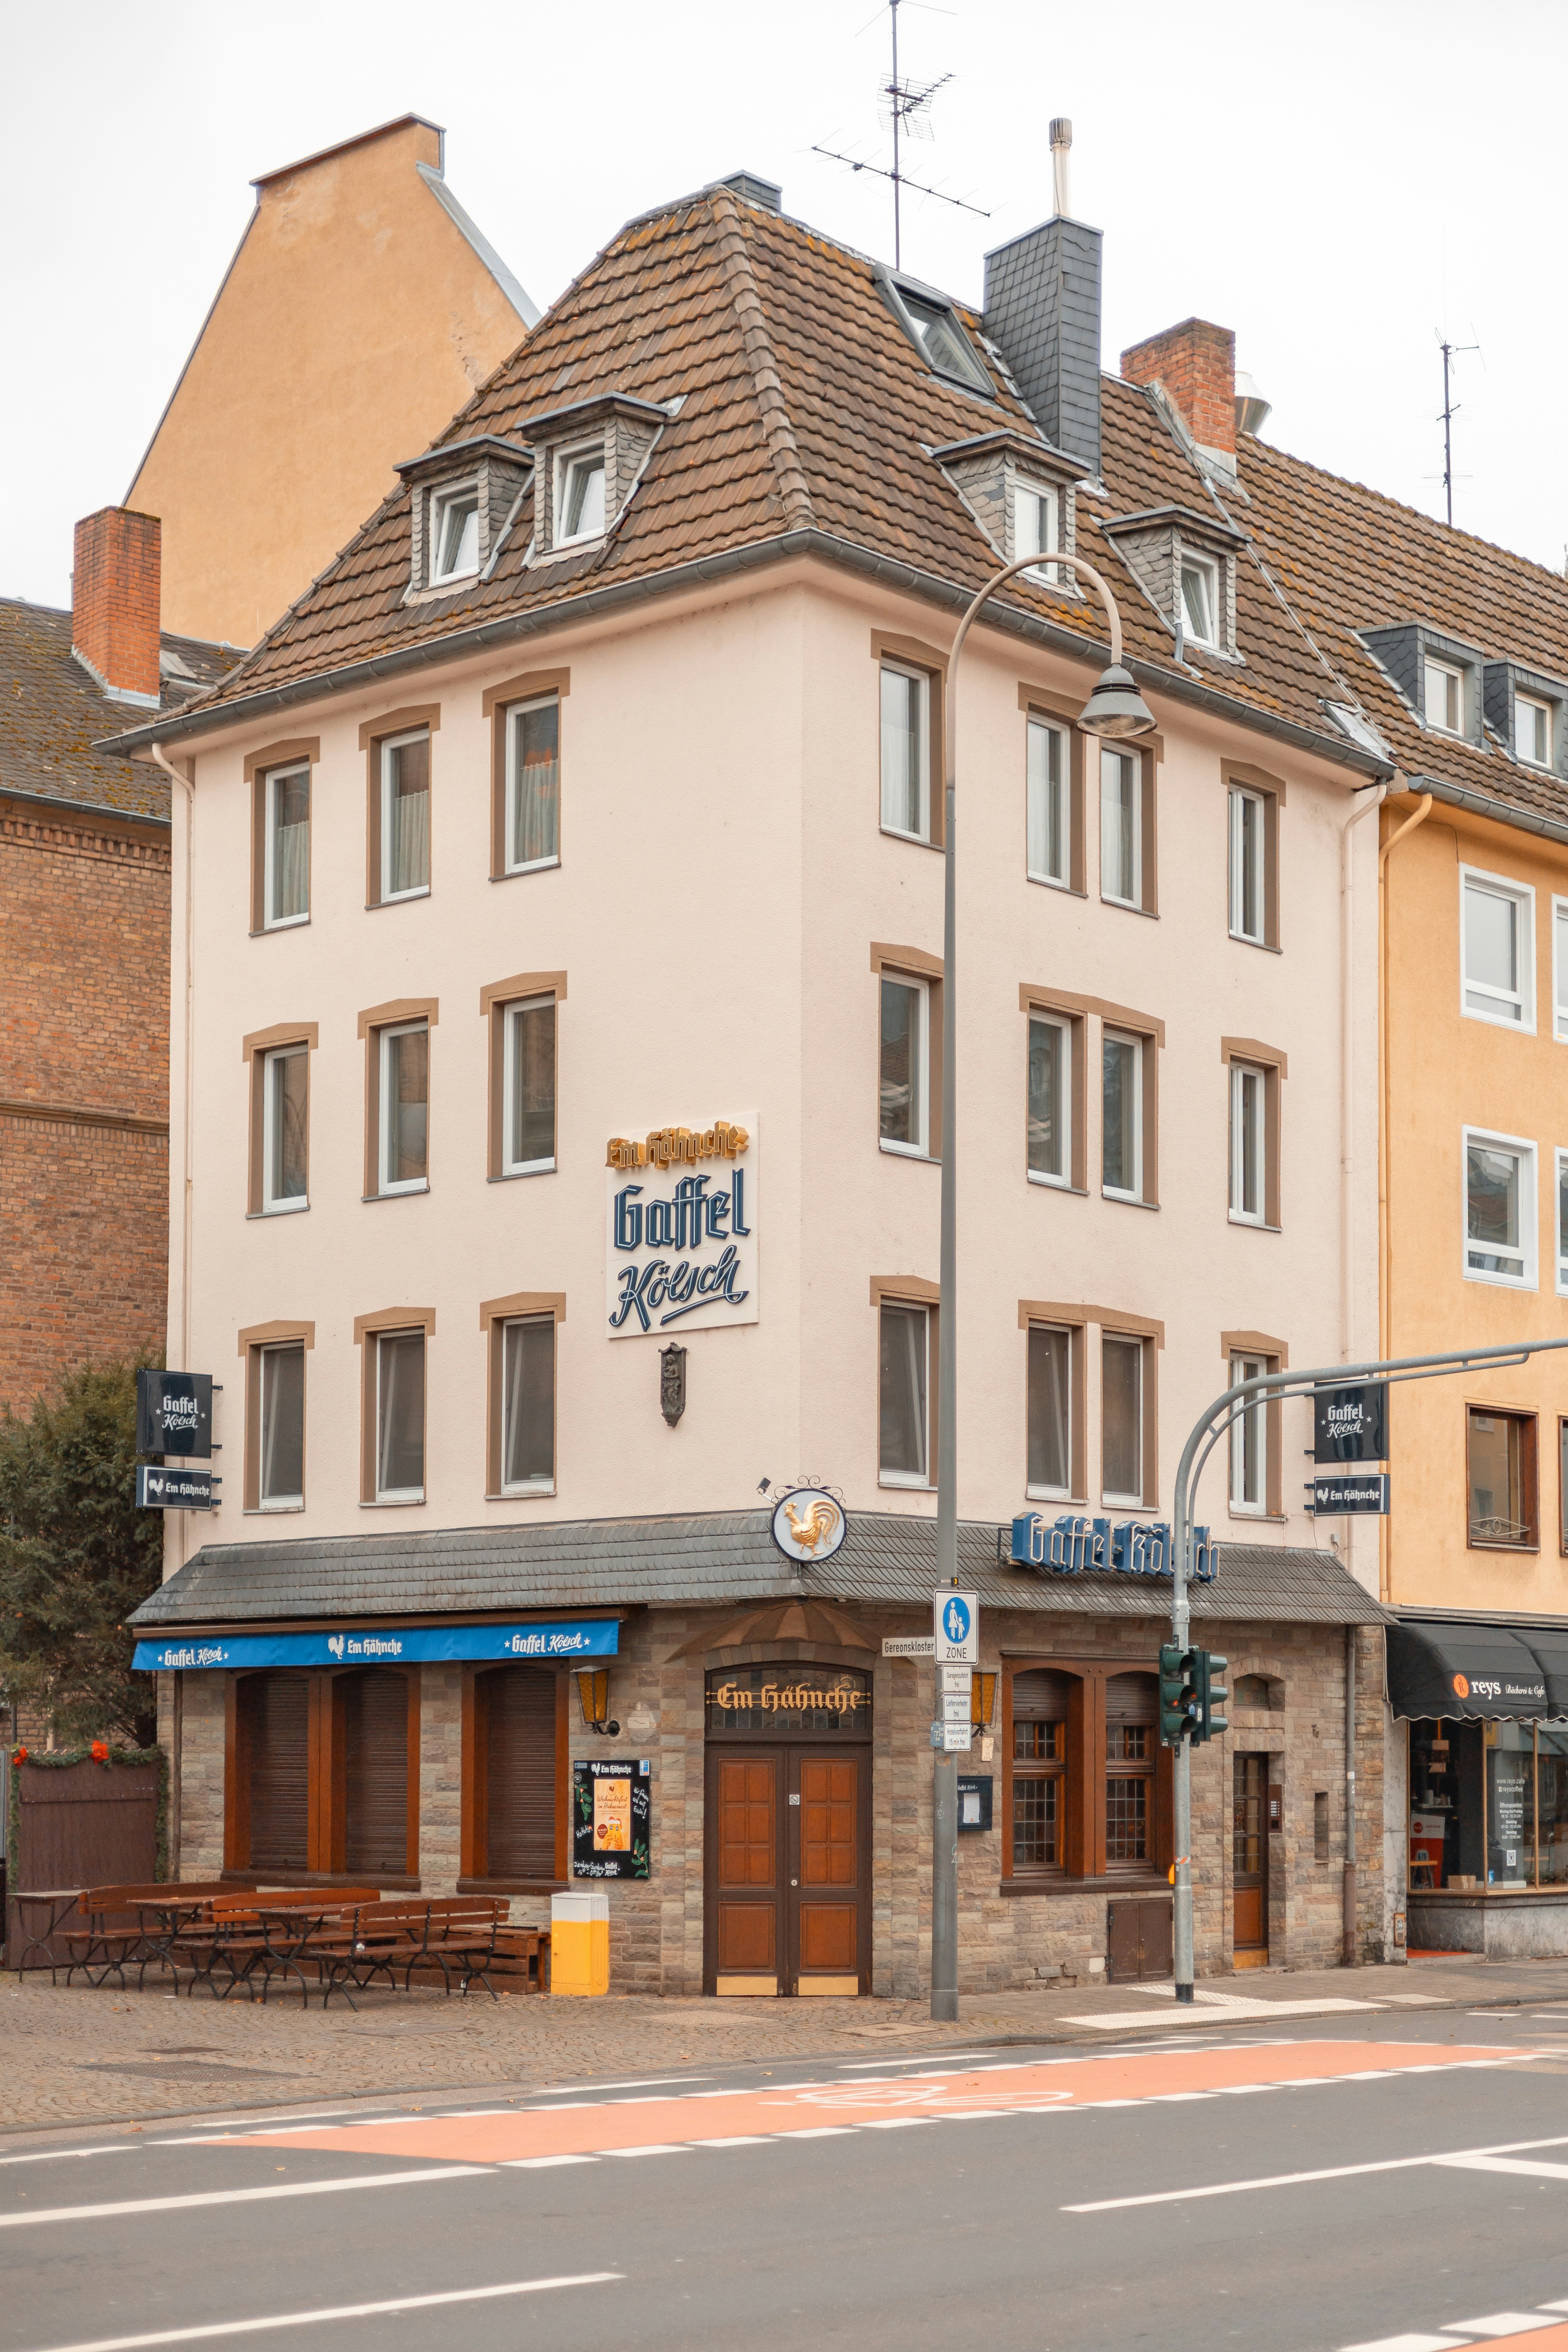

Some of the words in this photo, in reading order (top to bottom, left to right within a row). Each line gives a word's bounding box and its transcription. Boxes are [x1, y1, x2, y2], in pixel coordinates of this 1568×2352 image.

[605, 1138, 642, 1170] Em
[645, 1121, 749, 1170] Hähnche
[614, 1168, 750, 1251] Gaffel
[609, 1245, 749, 1332] Kölsch
[163, 1395, 199, 1414] Gaffel
[1328, 1404, 1364, 1421] Gaffel
[162, 1414, 198, 1430] Kölsch
[1327, 1420, 1364, 1439] Kölsch
[165, 1482, 178, 1494] Em
[180, 1482, 210, 1497] Hähnche
[1330, 1490, 1342, 1500] Em
[1344, 1489, 1380, 1501] Hähnche
[1012, 1512, 1116, 1574] Gaffel
[1113, 1520, 1220, 1583] Kölch
[347, 1640, 362, 1654] Em
[363, 1639, 402, 1656] Hähnche
[512, 1634, 546, 1654] Gaffel
[547, 1632, 583, 1653] Kölsch
[885, 1641, 934, 1652] Gereonskloster
[946, 1647, 967, 1658] ZONE
[164, 1649, 196, 1667] Gaffel
[196, 1646, 222, 1666] Kölsch
[717, 1681, 753, 1709] Em
[761, 1682, 861, 1714] Hähnche
[1471, 1681, 1501, 1700] reys
[1505, 1684, 1527, 1695] Bäckerei
[610, 1765, 631, 1774] Hähnche
[597, 1795, 628, 1804] Weihnachtsfest
